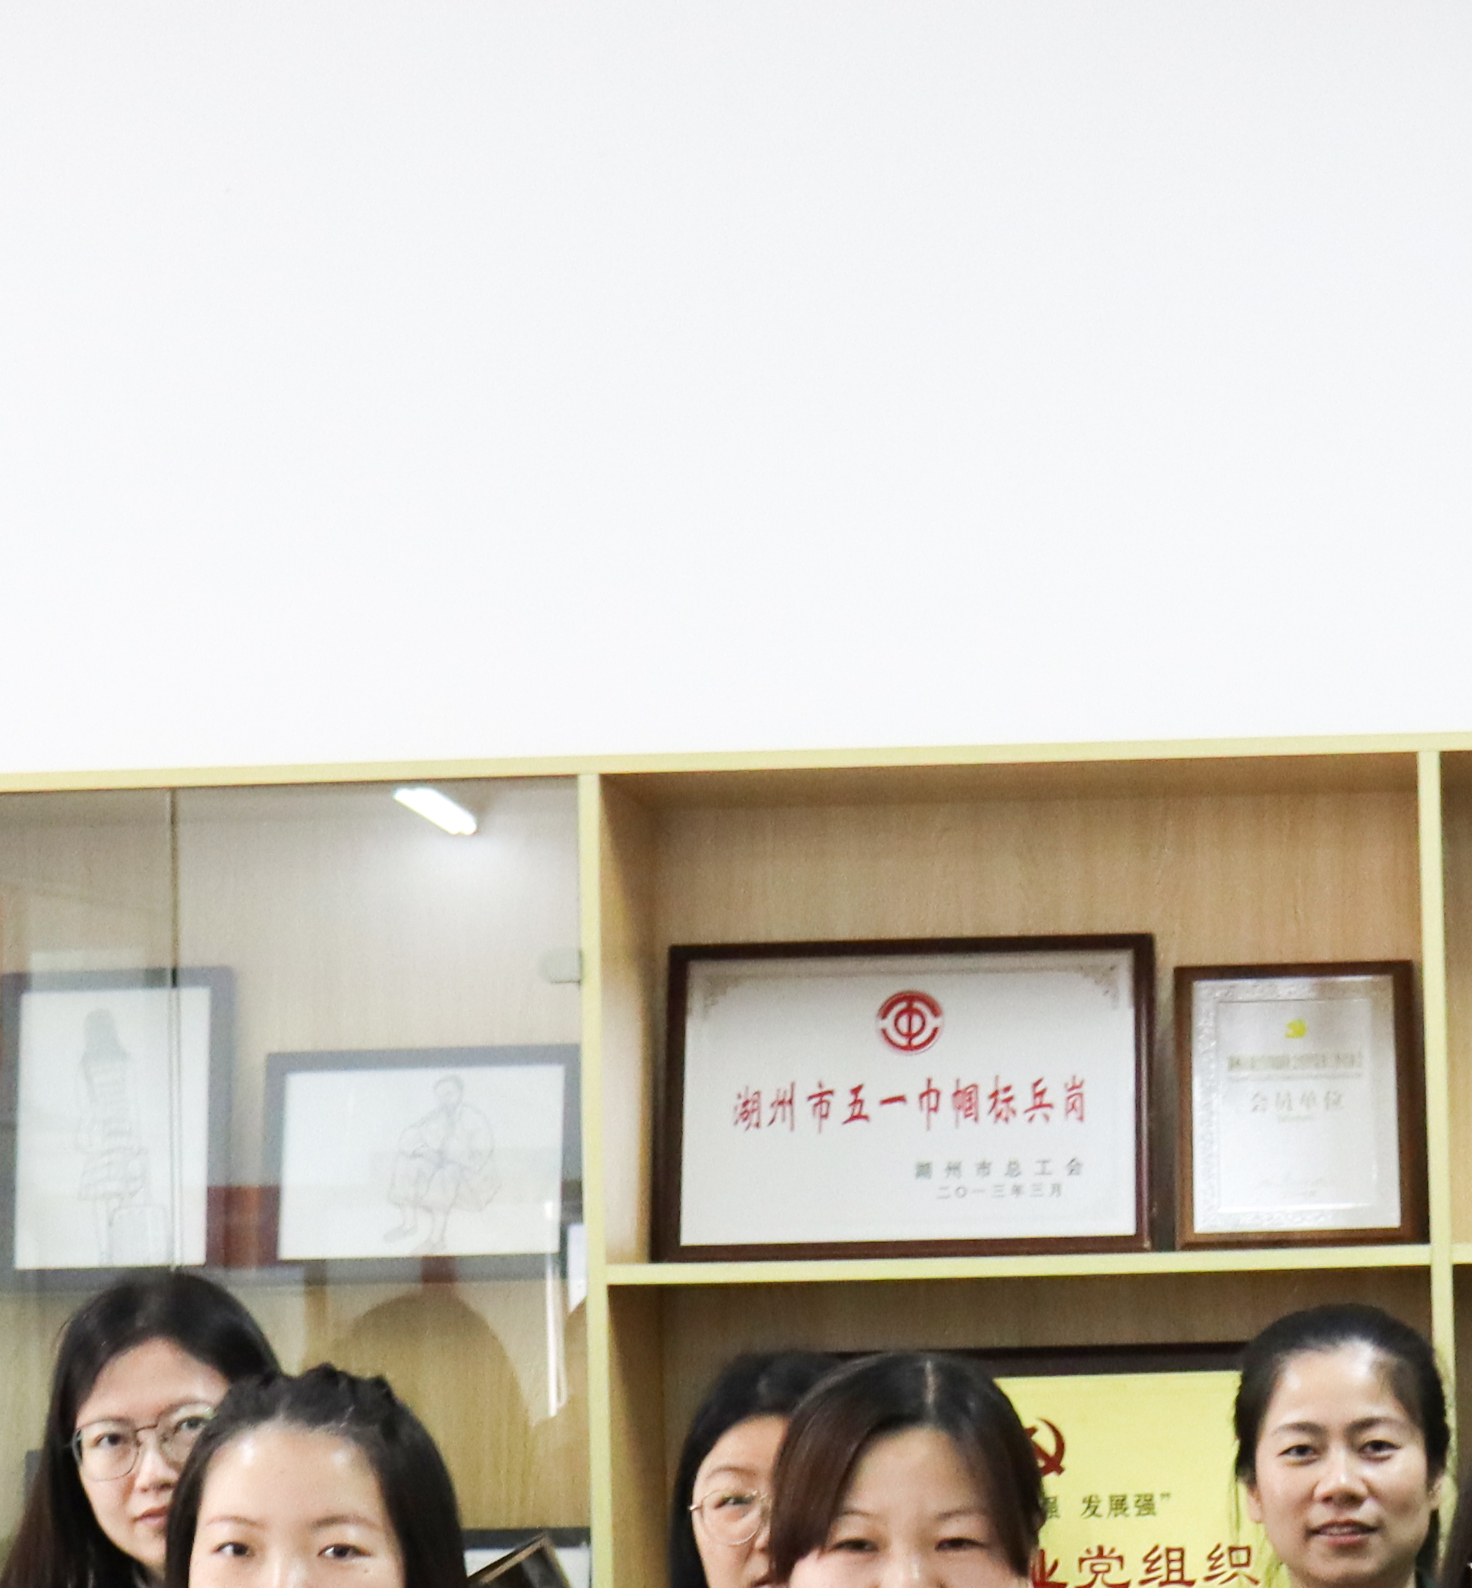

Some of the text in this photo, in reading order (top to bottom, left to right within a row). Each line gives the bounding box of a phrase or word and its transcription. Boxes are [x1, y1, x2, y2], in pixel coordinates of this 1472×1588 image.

[733, 1075, 1086, 1134] 湖州市五一巾帼标兵岗
